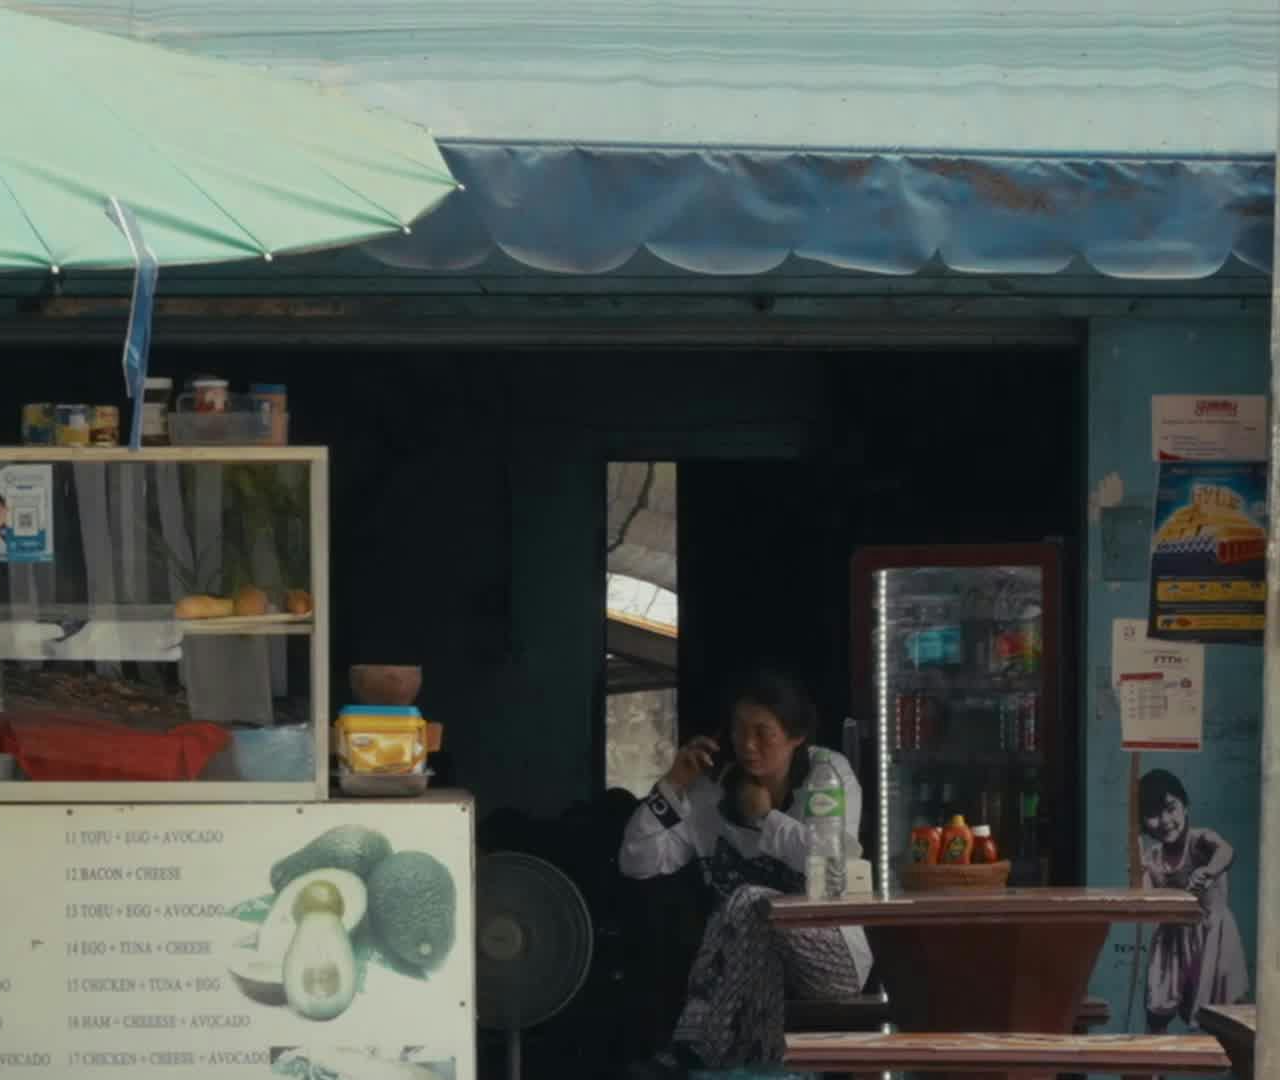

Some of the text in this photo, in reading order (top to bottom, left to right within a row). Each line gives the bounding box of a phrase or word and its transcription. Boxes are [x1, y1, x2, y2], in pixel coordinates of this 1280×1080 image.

[162, 831, 224, 844] AVOCADO
[65, 867, 77, 881] 12
[80, 867, 122, 881] BACON
[135, 867, 181, 881] CHEESE
[125, 904, 151, 918] EGG
[163, 904, 225, 918] AVOCADO
[81, 978, 136, 992] CHICKEN
[189, 1015, 251, 1029] AVOCADO
